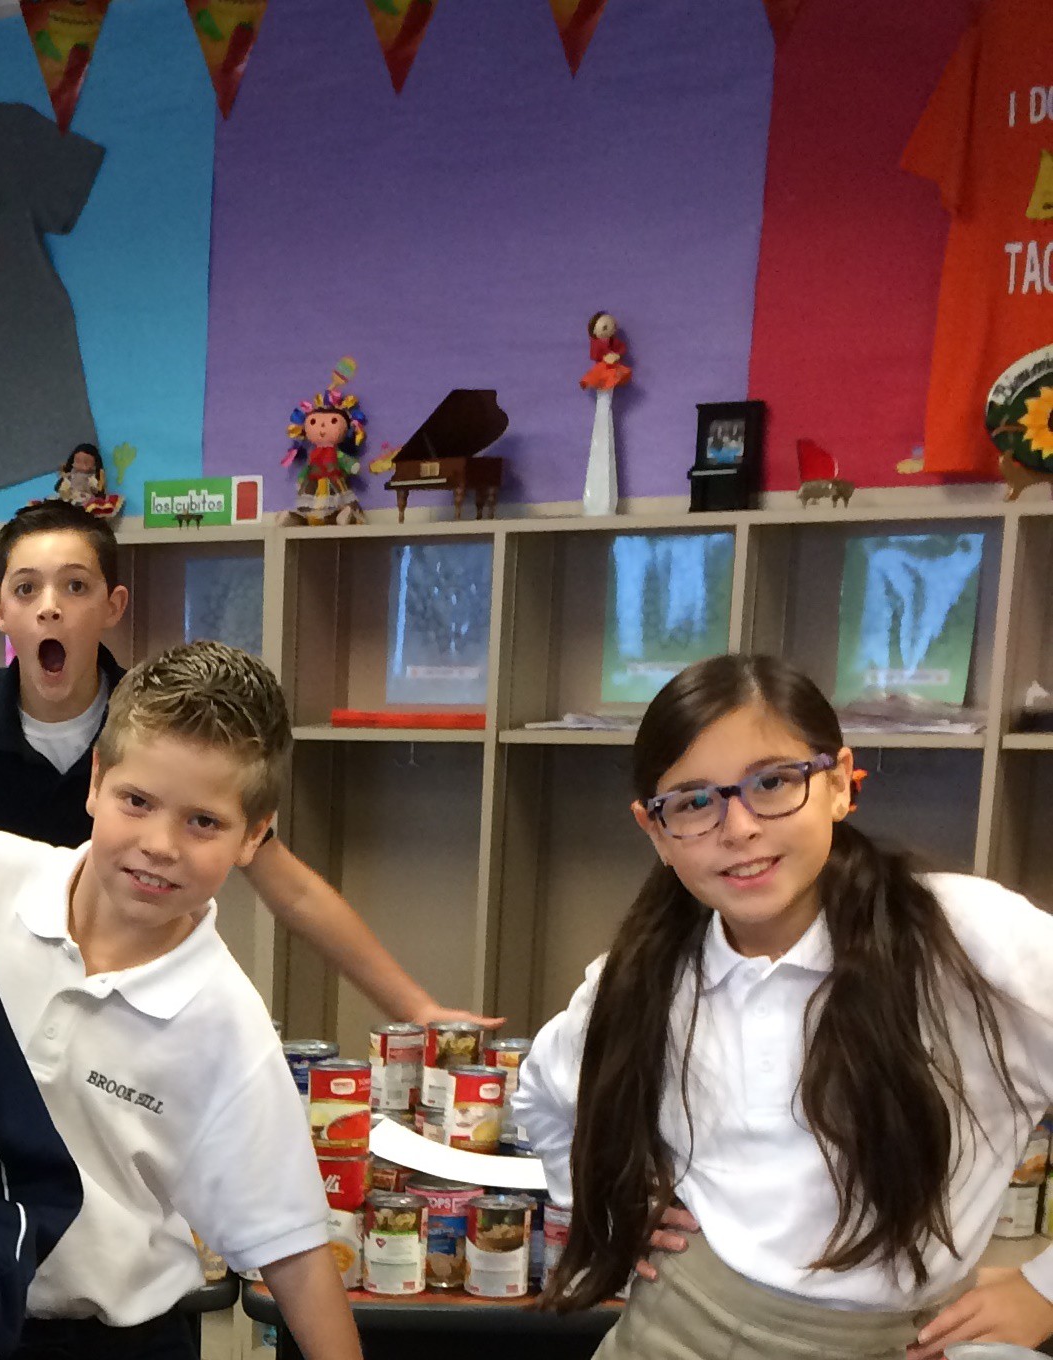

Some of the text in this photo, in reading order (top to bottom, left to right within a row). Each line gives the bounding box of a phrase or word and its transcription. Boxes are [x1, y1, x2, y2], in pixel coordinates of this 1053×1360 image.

[152, 496, 170, 513] los
[86, 1070, 164, 1115] BROOK HILL
